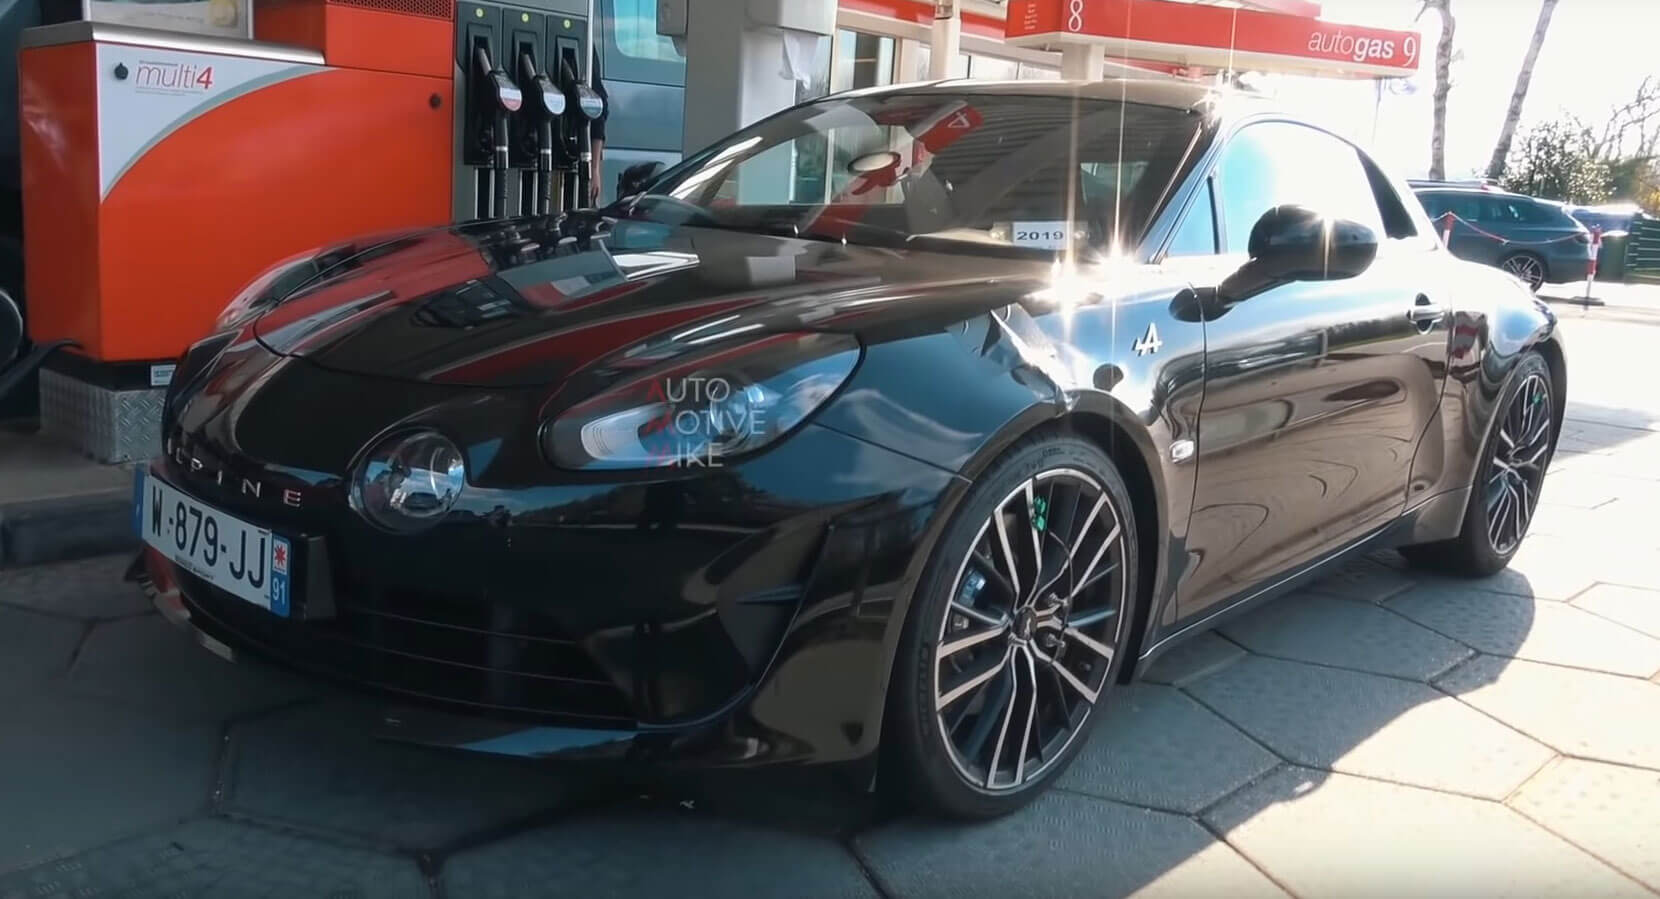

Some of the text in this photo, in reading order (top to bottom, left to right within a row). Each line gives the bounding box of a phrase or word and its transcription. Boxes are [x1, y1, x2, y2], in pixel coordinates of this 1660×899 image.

[1068, 0, 1083, 32] 8
[1308, 30, 1417, 67] autogas 9
[136, 64, 213, 90] multi4
[1016, 230, 1064, 241] 2019
[272, 577, 287, 606] 91
